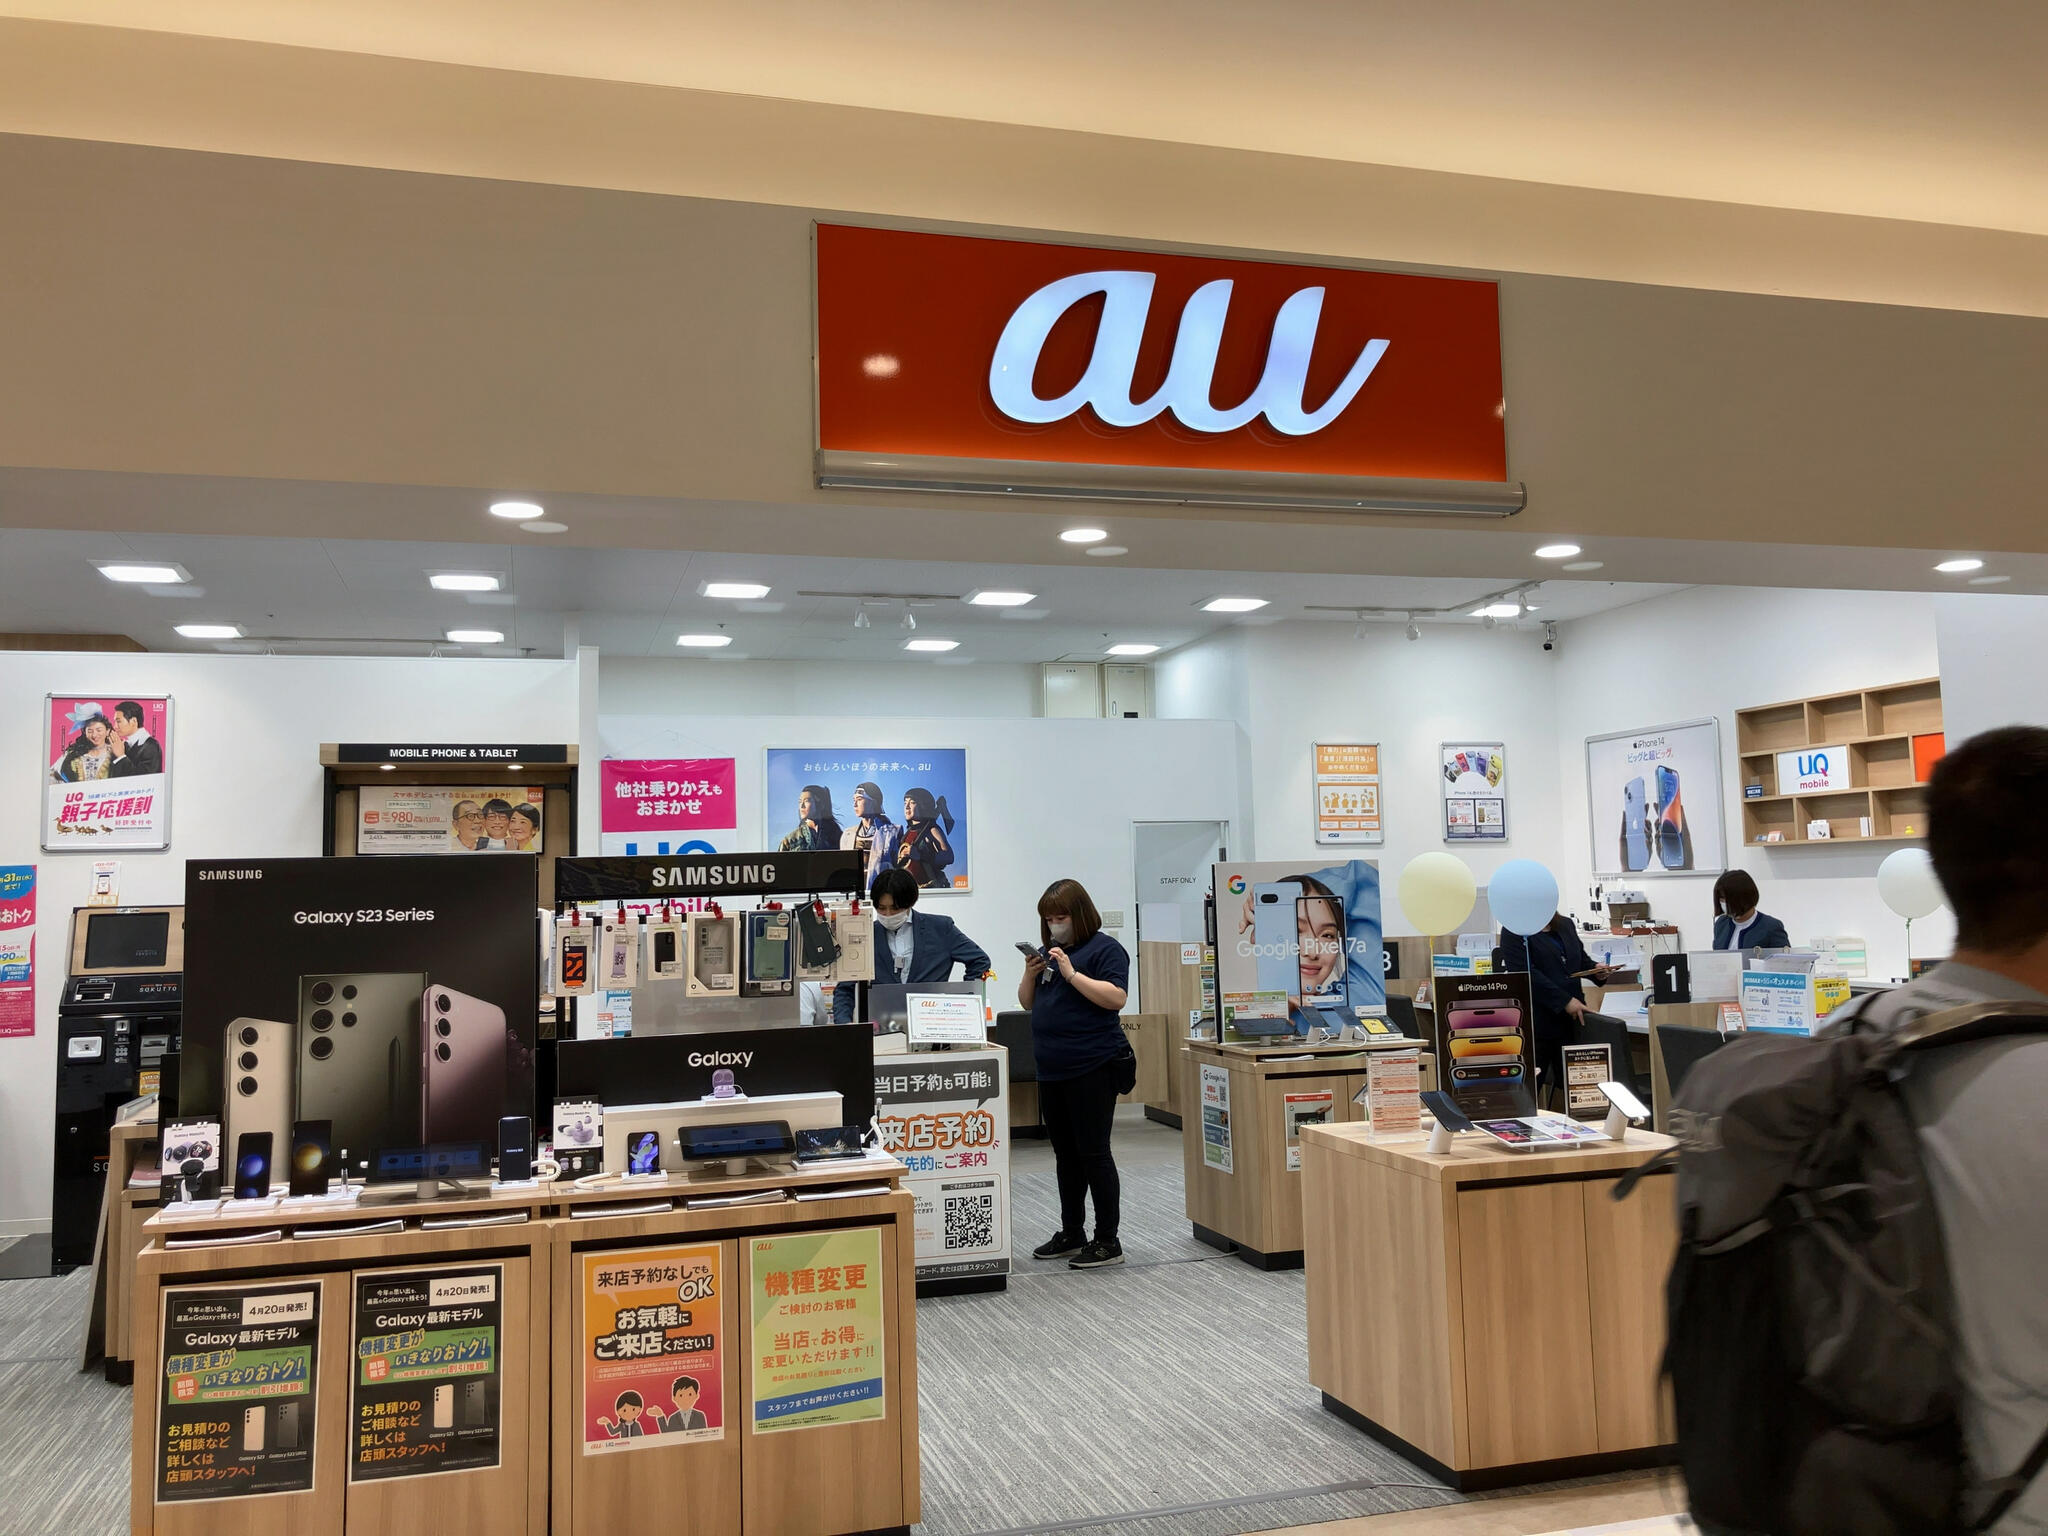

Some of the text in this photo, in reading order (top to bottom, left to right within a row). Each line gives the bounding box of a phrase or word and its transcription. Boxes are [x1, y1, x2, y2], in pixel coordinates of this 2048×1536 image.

[989, 271, 1390, 435] au
[1638, 736, 1665, 749] iPhone 14
[389, 749, 518, 758] MOBILE PHONE & TABLET
[803, 762, 931, 772] おもしろいほうの未来へ。 au
[1798, 753, 1829, 777] UQ
[615, 780, 723, 798] 他社乗りかえも
[1800, 779, 1829, 790] mobile
[65, 792, 84, 803] UQ
[60, 795, 153, 823] 親子応援割
[637, 799, 702, 816] おまかせ
[391, 811, 413, 823] 980
[199, 869, 263, 881] SAMSUNG
[652, 864, 776, 887] SAMSUNG
[294, 908, 435, 926] Galaxy S23 Series
[1237, 936, 1367, 961] Google Pixel 7a
[1463, 984, 1487, 992] iPhone
[1496, 982, 1508, 990] Pro
[1665, 965, 1677, 993] 1
[1120, 1023, 1142, 1031] ONLY
[688, 1050, 754, 1068] Galaxy
[874, 1071, 992, 1094] 当日予約も可能!
[880, 1113, 992, 1150] 来店予約
[896, 1151, 988, 1172] 先的にご案内
[756, 1242, 774, 1251] au
[597, 1264, 709, 1288] 来店予約なしでも
[764, 1264, 867, 1298] 機種変更
[436, 1284, 490, 1296] 4月20日発売!
[679, 1276, 714, 1301] OK
[249, 1302, 308, 1316] 4月20日発売!
[779, 1298, 857, 1315] ご検討のお客様
[376, 1308, 483, 1327] Galaxy 最新モデル
[618, 1305, 690, 1330] お気軽に
[185, 1327, 300, 1346] Galaxy 最新モデル
[360, 1329, 424, 1357] 機種変更が
[597, 1332, 712, 1358] ご来店ください!
[774, 1325, 865, 1351] 当店でお得に
[395, 1337, 488, 1365] いきなりおトク!
[762, 1345, 874, 1369] 変更いただけます!!
[168, 1349, 236, 1376] 機種変更が
[204, 1357, 303, 1385] いきなりおトク!
[361, 1400, 421, 1416] お見積りの
[767, 1386, 869, 1413] スタッフまでお声がけください!!
[168, 1422, 230, 1437] お見積りの
[361, 1414, 420, 1431] ご相談など
[168, 1436, 231, 1452] ご相談など
[360, 1431, 406, 1447] 詳しくは
[167, 1454, 214, 1468] 詳しくは
[360, 1442, 446, 1462] 店頭スタッフへ!
[166, 1465, 256, 1483] 店頭スタッフへ!
